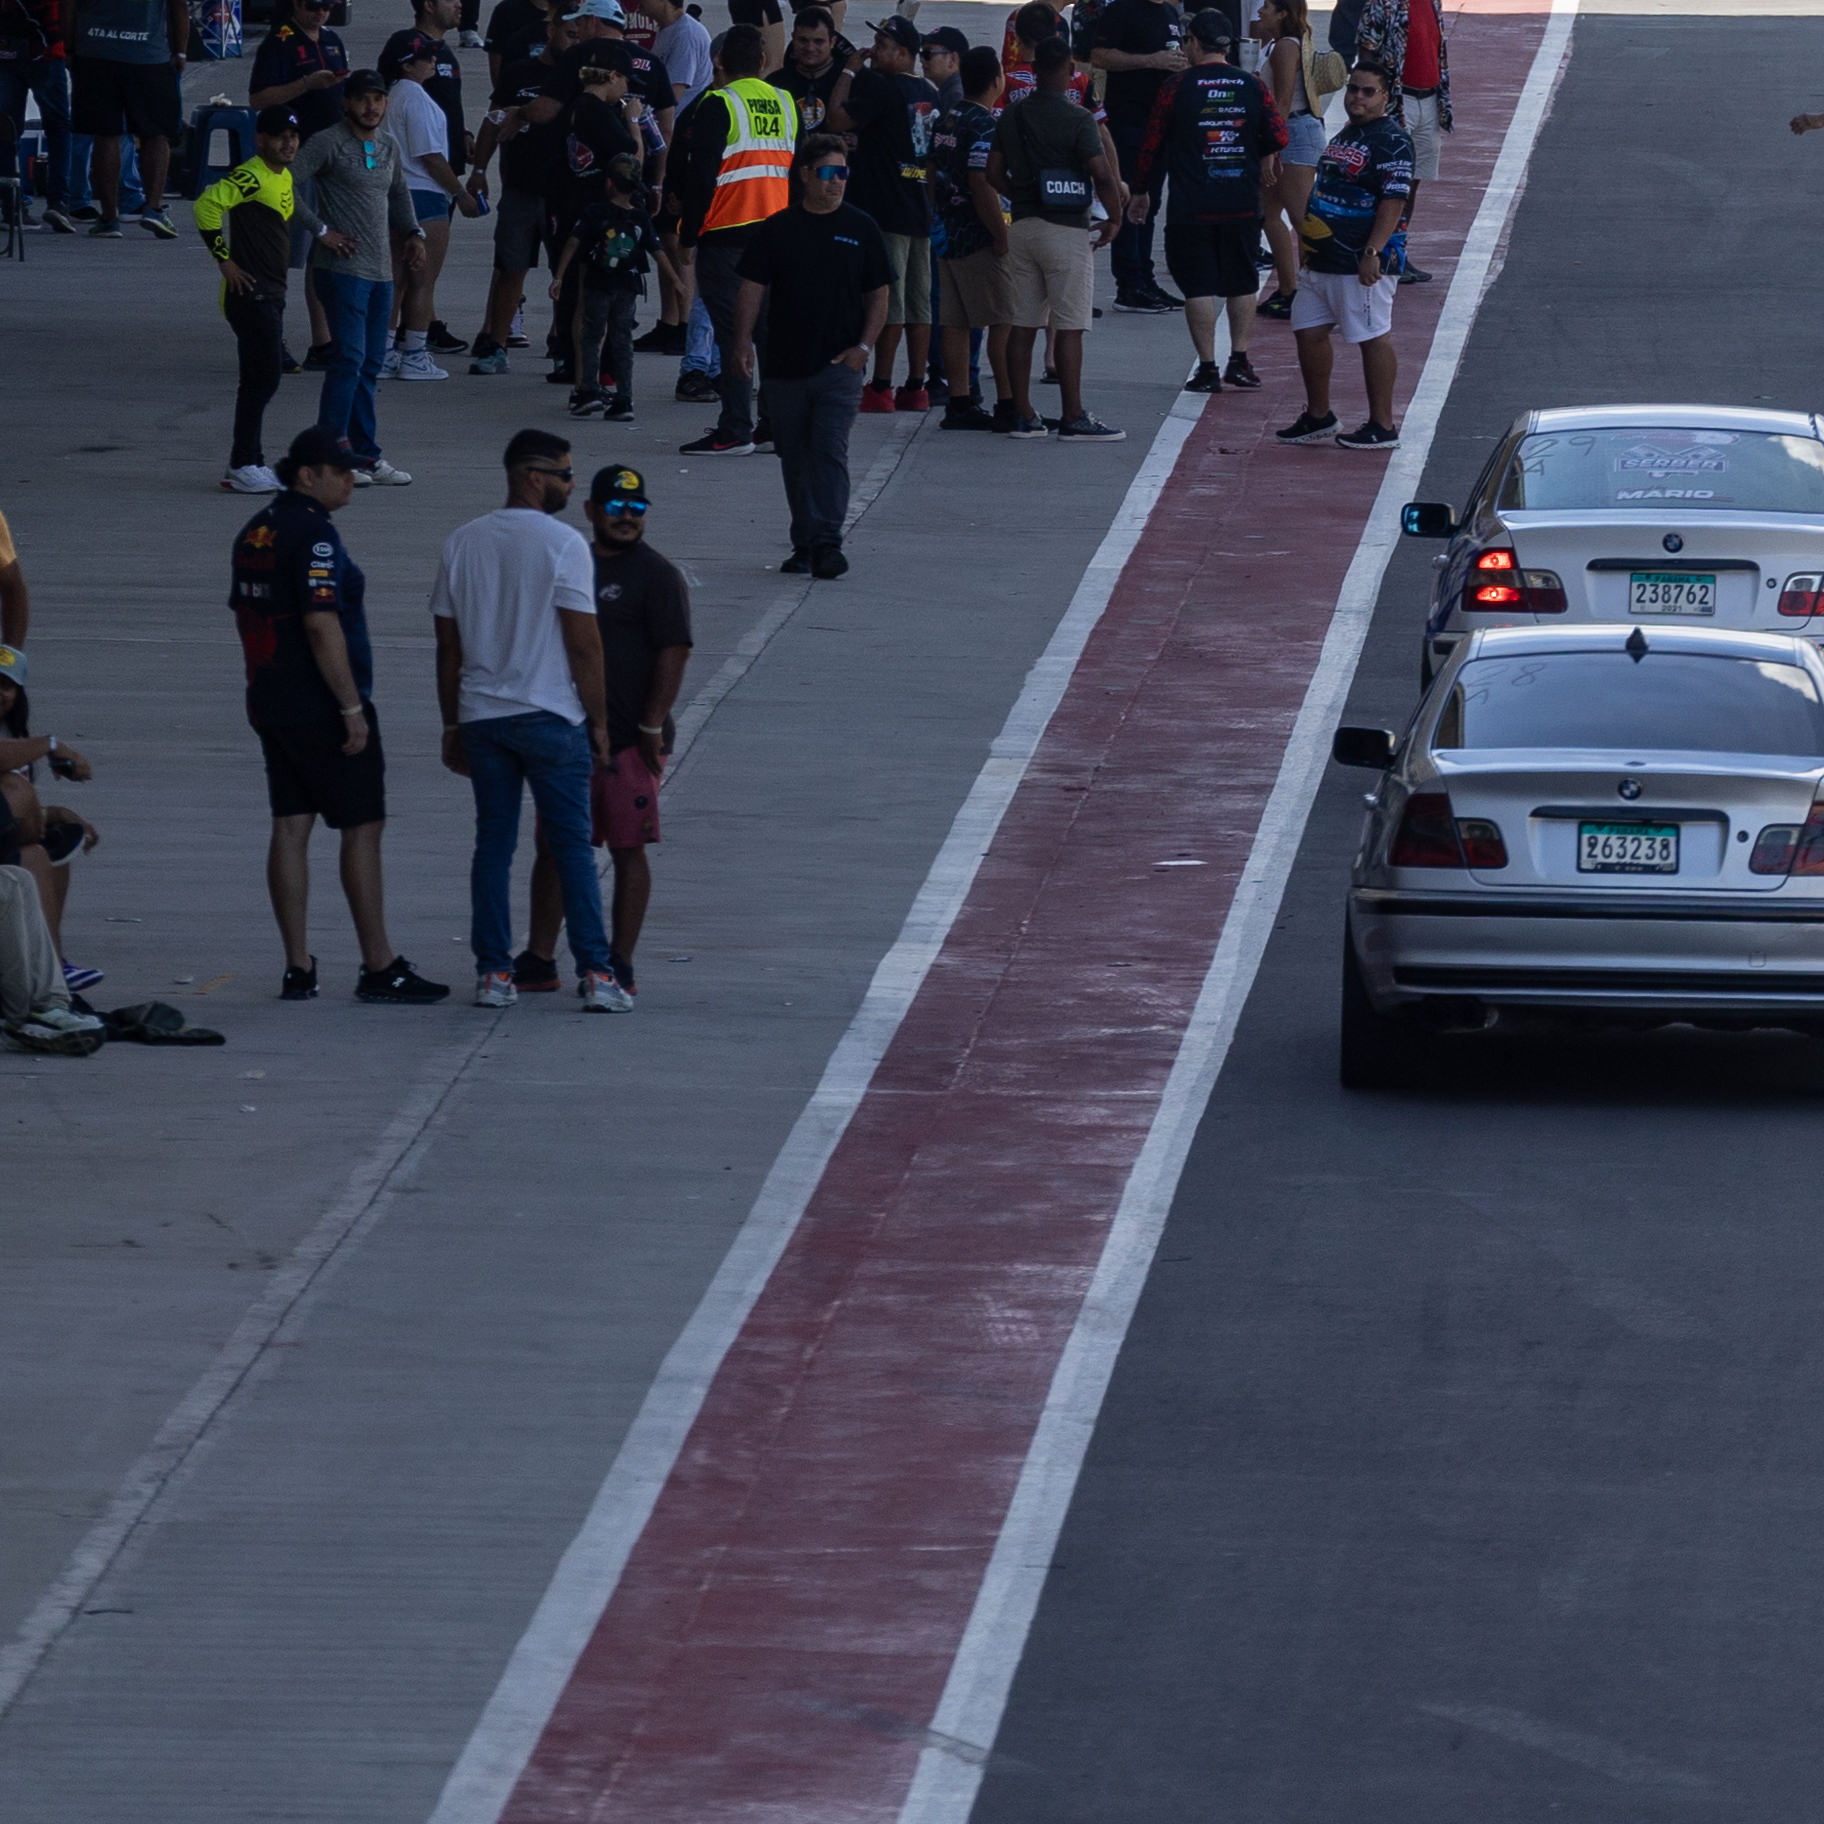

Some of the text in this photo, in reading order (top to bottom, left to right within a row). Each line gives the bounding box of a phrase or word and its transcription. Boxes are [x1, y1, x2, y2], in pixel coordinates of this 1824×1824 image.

[1046, 179, 1086, 196] COACH
[1616, 487, 1717, 501] MARIO
[1635, 583, 1710, 605] 238762
